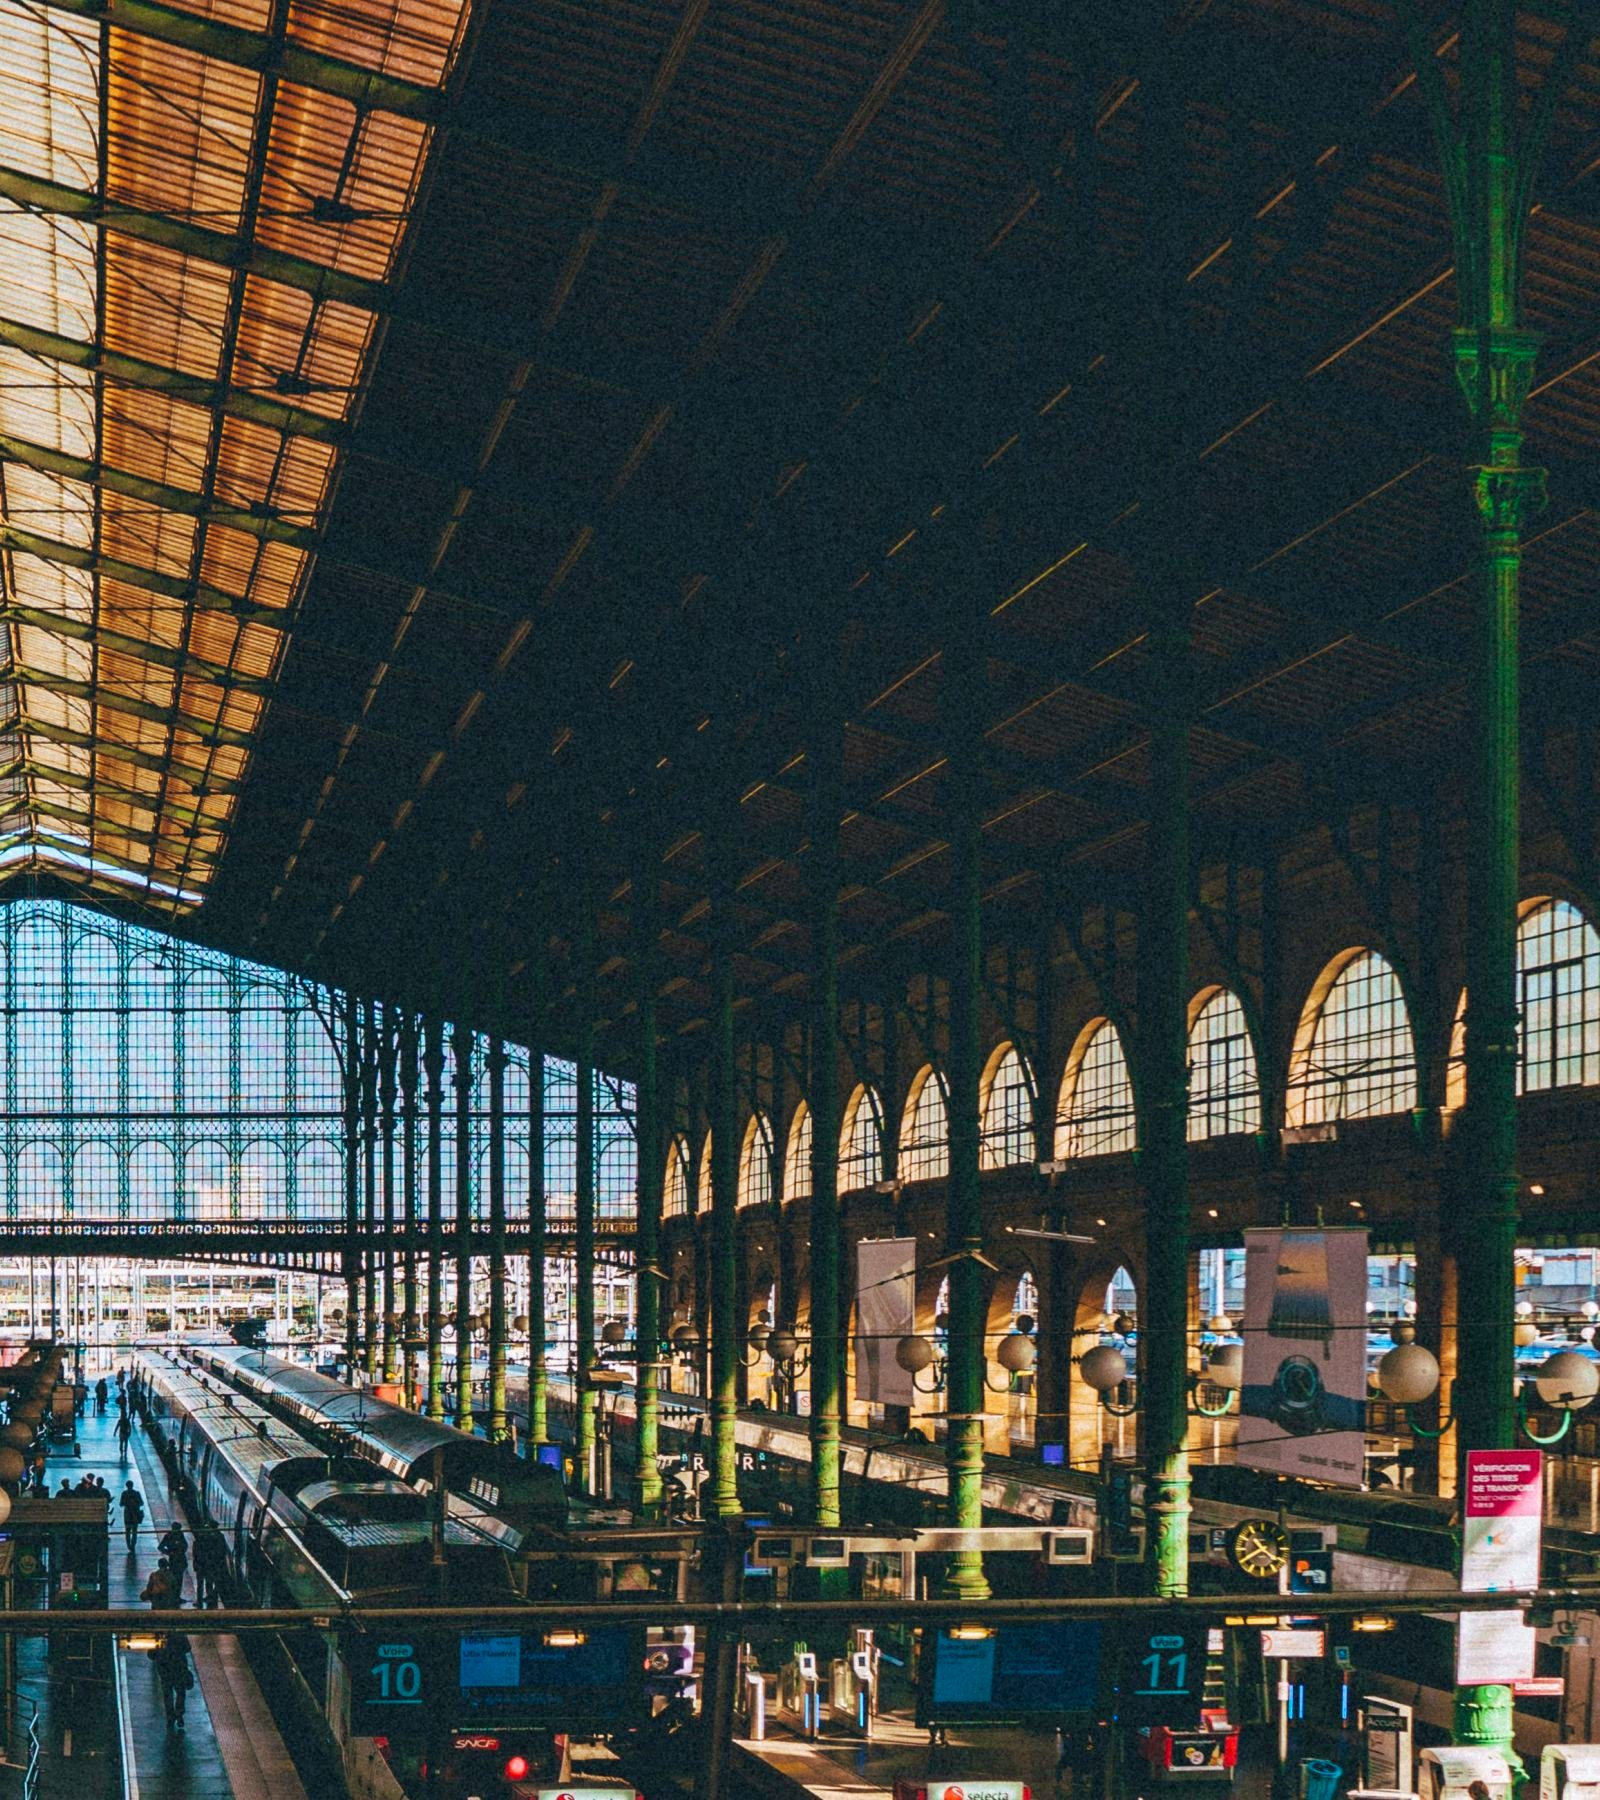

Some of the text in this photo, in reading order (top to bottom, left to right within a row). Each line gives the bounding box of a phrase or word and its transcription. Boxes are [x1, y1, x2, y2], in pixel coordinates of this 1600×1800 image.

[1472, 1463, 1531, 1472] VÉRIFICATION
[1491, 1474, 1519, 1482] TITRES
[381, 1646, 410, 1656] Voie
[1141, 1653, 1187, 1688] 11
[371, 1662, 421, 1697] 10
[1367, 1718, 1404, 1727] Accueil
[454, 1739, 498, 1749] SNCF
[967, 1791, 1009, 1800] selecta
